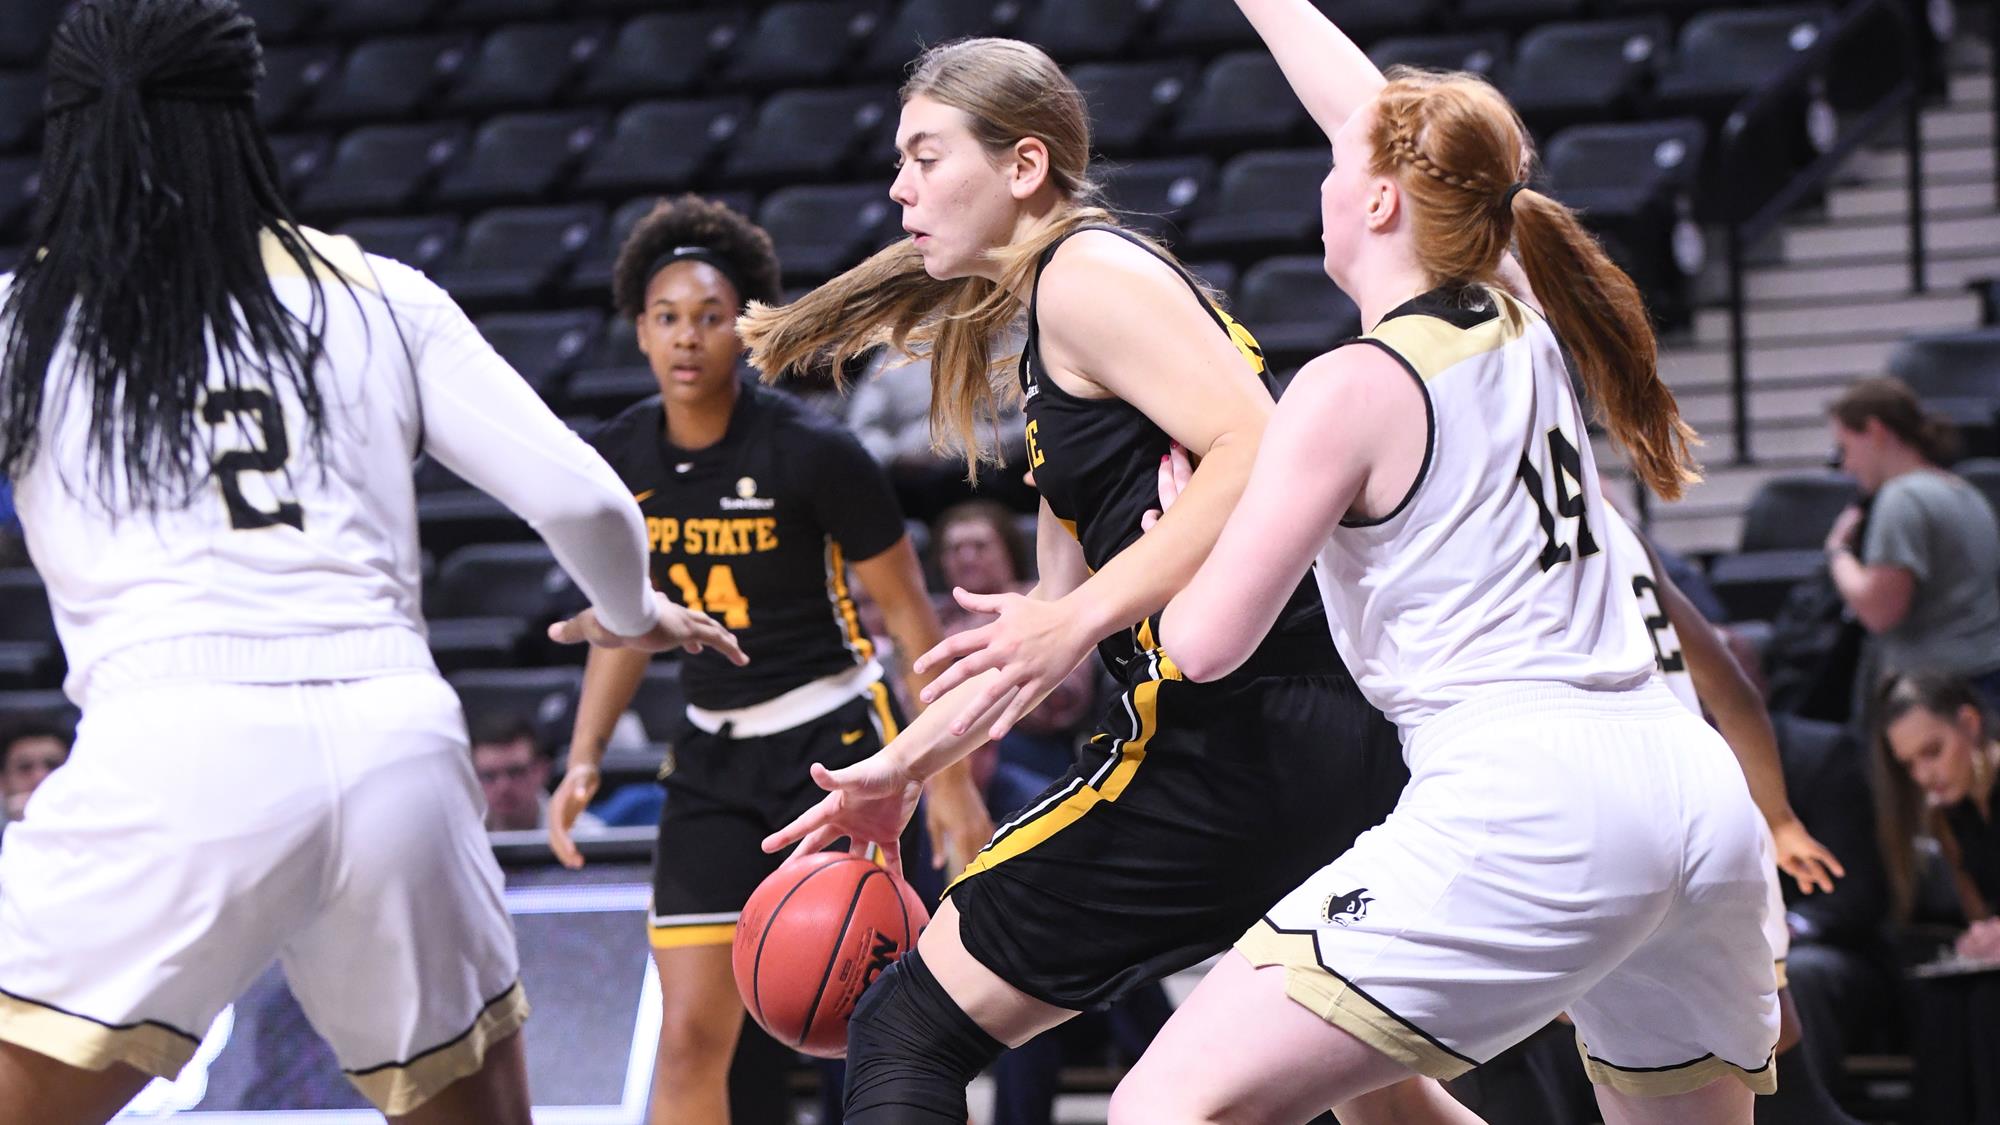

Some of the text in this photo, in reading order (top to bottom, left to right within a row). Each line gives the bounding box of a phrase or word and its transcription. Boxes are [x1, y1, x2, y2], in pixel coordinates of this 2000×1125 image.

[203, 390, 305, 532] 2
[1516, 426, 1600, 574] 14
[646, 517, 778, 555] PP STATE
[668, 563, 751, 630] 14
